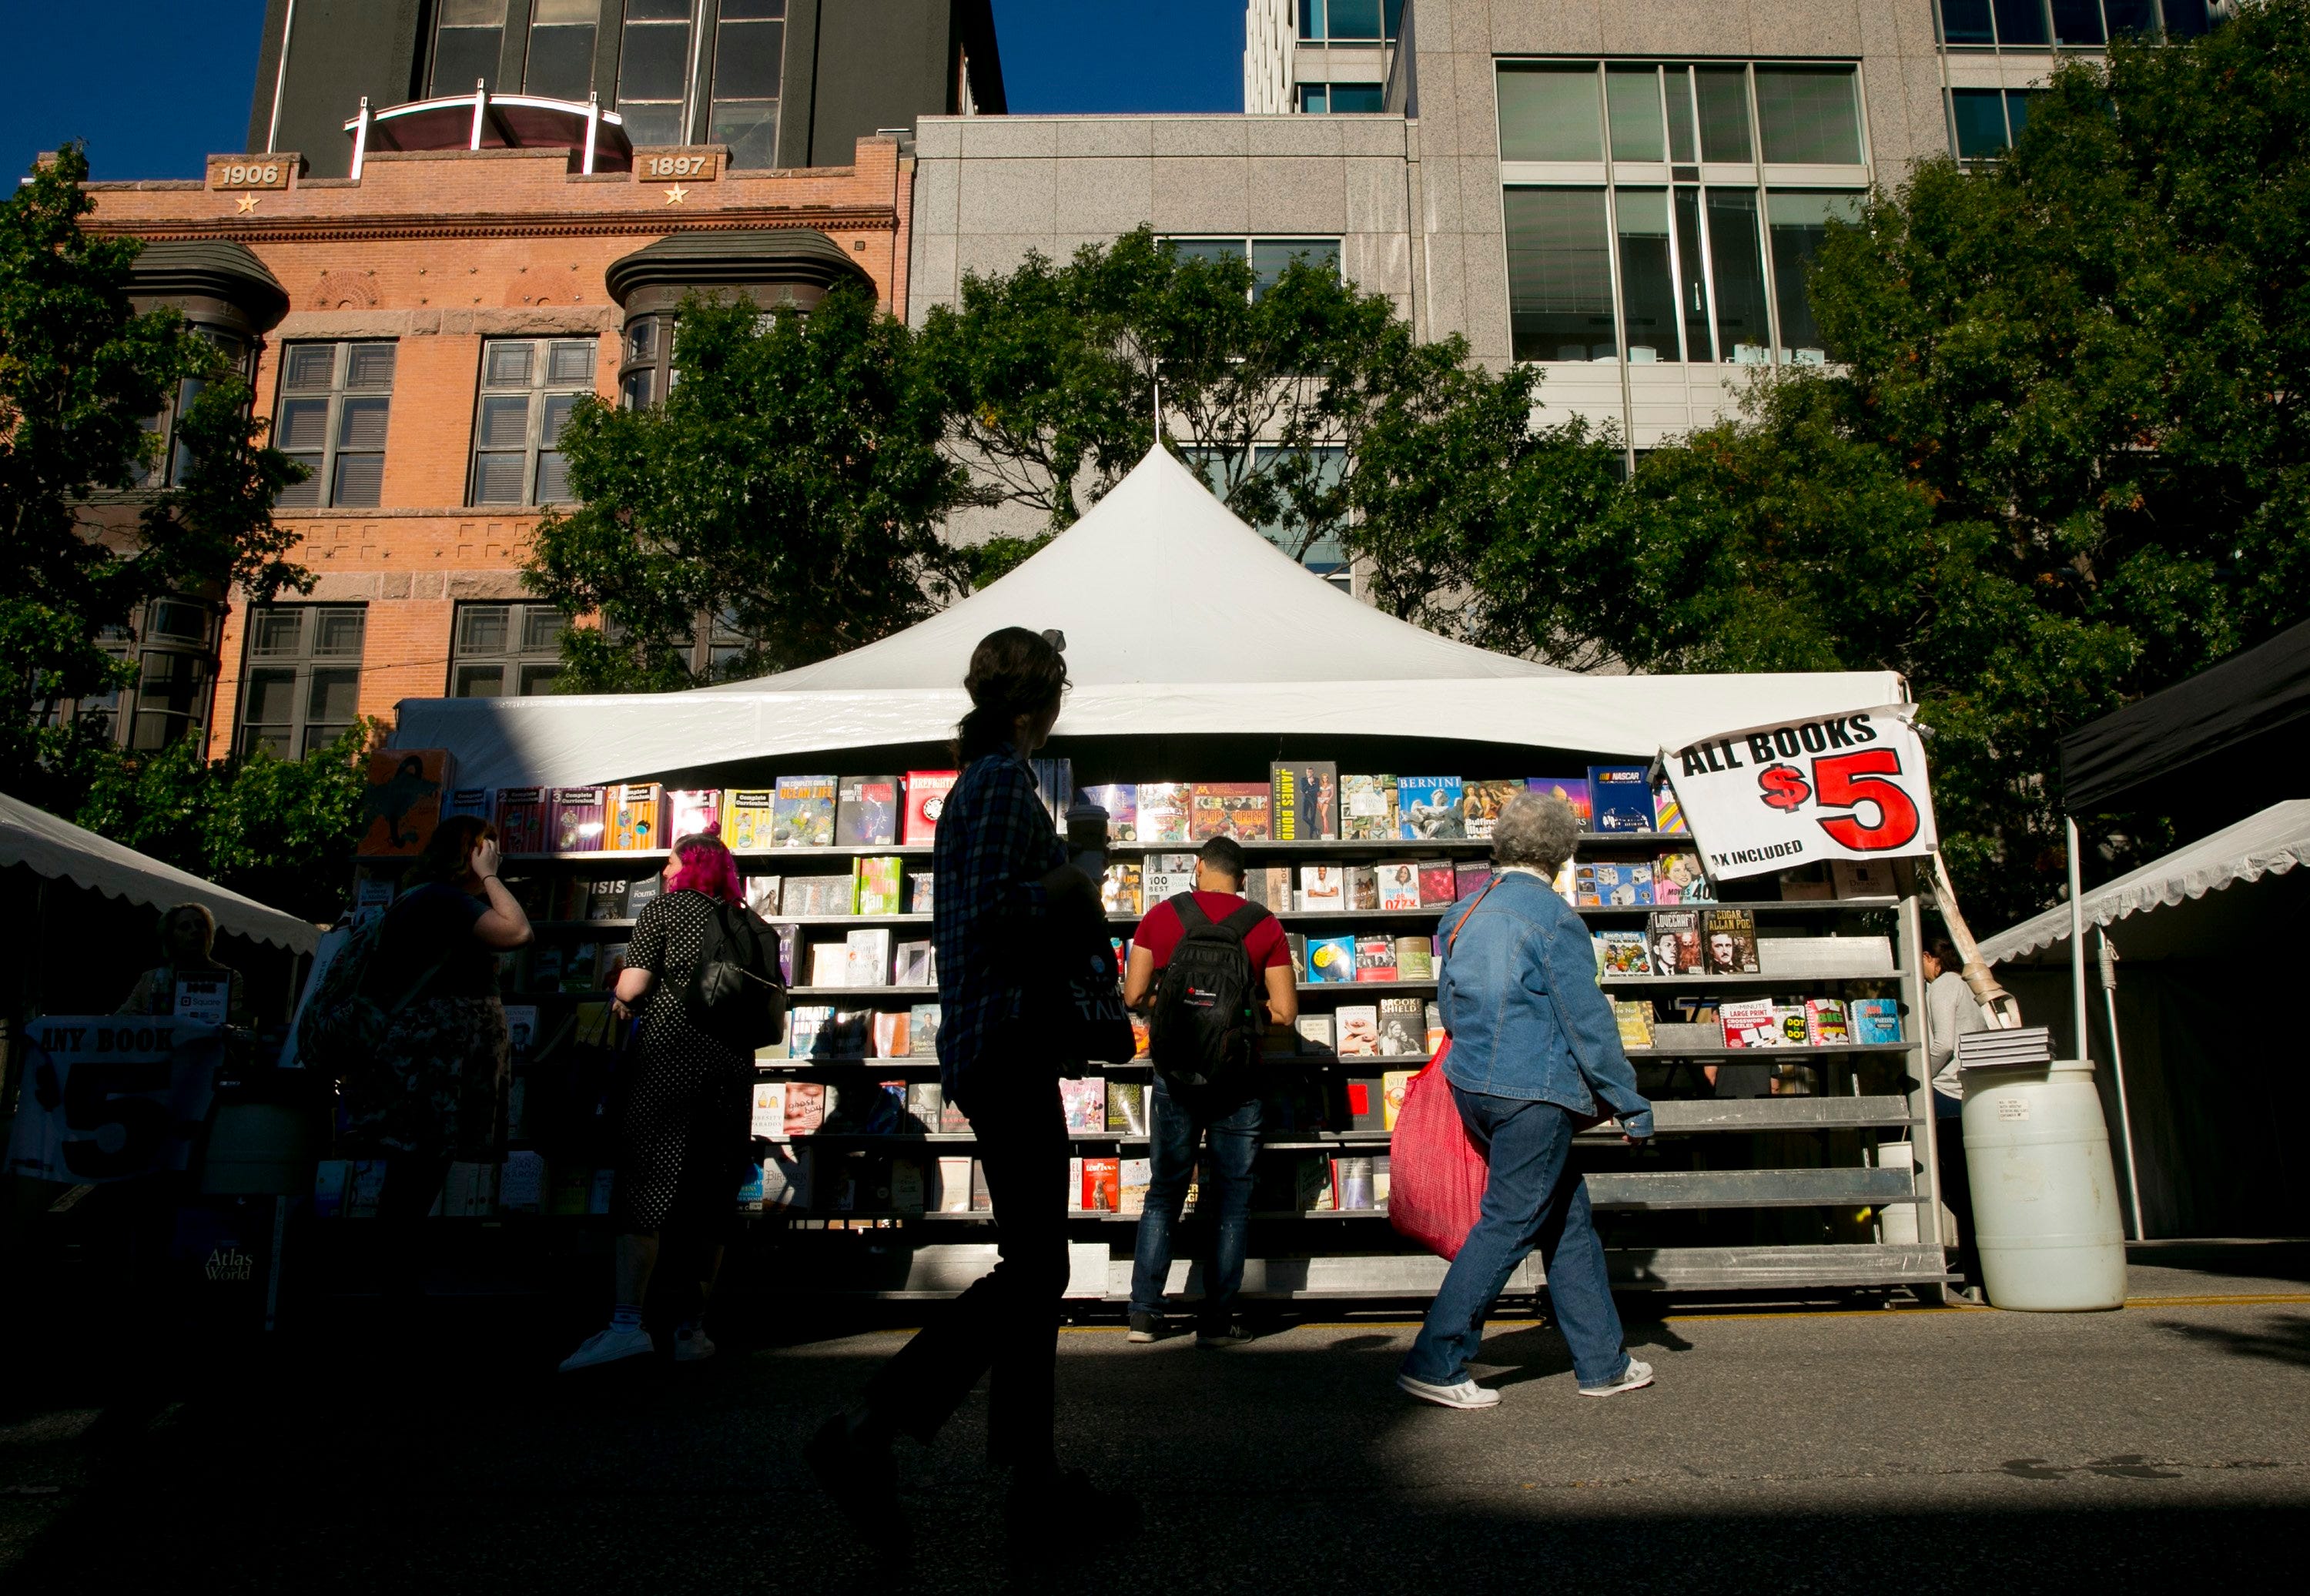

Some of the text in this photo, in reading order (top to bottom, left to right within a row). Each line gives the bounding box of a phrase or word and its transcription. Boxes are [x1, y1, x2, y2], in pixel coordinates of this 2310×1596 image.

[649, 156, 706, 176] 1897
[223, 165, 278, 184] 1906
[1680, 713, 1877, 777] ALL BOOKS
[1400, 778, 1460, 788] BERNINI
[780, 786, 832, 799] OCEAN LIFE
[1281, 768, 1295, 840] JAMES BOND
[1758, 747, 1920, 852] $5
[1232, 810, 1267, 821] GOPHERS
[1465, 818, 1498, 826] Bulfinc
[1466, 825, 1494, 834] Illust
[1710, 839, 1803, 868] AX INCLUDED
[591, 879, 627, 895] ISIS
[1149, 876, 1167, 885] 100
[1667, 888, 1690, 896] MOVIES
[1384, 899, 1418, 910] OZZY
[1716, 909, 1742, 919] EDGAR
[1655, 914, 1695, 928] LOVECRAFT
[1709, 919, 1751, 930] ALLAN POE
[192, 998, 221, 1006] Square
[1817, 1012, 1843, 1022] BIG
[41, 1028, 86, 1052] ANY
[1109, 1083, 1140, 1092] STAR
[788, 1096, 815, 1113] ghost
[1109, 1102, 1140, 1116] FAQ
[206, 1247, 253, 1267] Atlas
[205, 1265, 251, 1281] World
